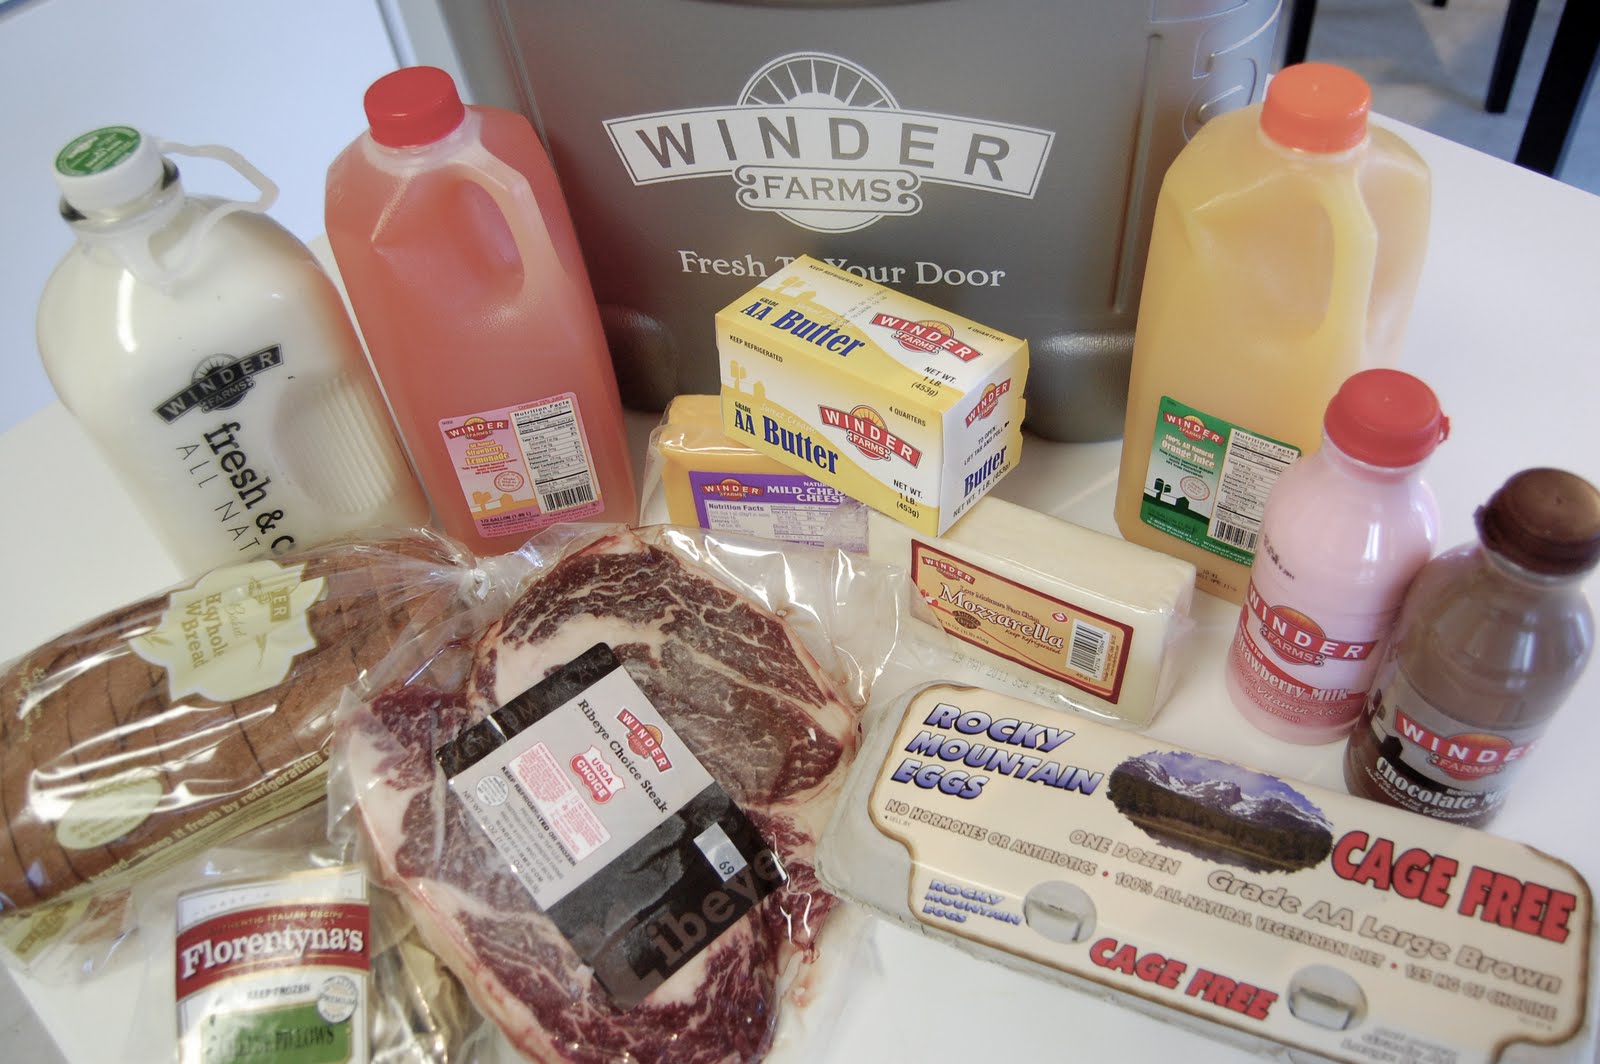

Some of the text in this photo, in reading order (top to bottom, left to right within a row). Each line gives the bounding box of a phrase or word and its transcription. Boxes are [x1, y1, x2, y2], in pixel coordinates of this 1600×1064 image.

[635, 116, 1011, 182] WINDER
[762, 176, 892, 202] FARMS
[678, 250, 767, 278] Fresh
[916, 261, 1006, 287] Door
[809, 264, 824, 272] KEEP
[759, 297, 779, 308] GRADE
[740, 301, 772, 321] AA
[771, 309, 866, 358] Butter
[880, 315, 975, 359] WINDER
[901, 334, 935, 353] FARMS
[974, 327, 1004, 343] QUARTERS
[729, 334, 784, 363] KEEP REFRIGERATED
[163, 349, 279, 419] WINDER
[923, 366, 941, 379] NET
[208, 379, 250, 408] FARMS
[910, 381, 939, 398] (453g)
[967, 381, 1008, 423] WINDER
[514, 406, 547, 417] Nutrition
[549, 400, 570, 409] Facts
[735, 401, 752, 414] GRADE
[895, 408, 927, 428] QUARTERS
[450, 421, 504, 437] WINDER
[735, 408, 839, 475] AA Butter
[825, 408, 918, 461] WINDER
[1166, 413, 1220, 443] WINDER
[466, 445, 503, 456] Strawberry
[853, 433, 884, 456] FARMS
[964, 453, 974, 467] LIFT
[983, 435, 993, 448] AND
[1161, 440, 1192, 459] Orange
[1193, 454, 1216, 469] Juice
[1234, 431, 1295, 456] Nutrition Facts
[466, 452, 509, 465] Lemonade
[963, 445, 1007, 499] Butter
[203, 421, 273, 511] fresh
[254, 508, 286, 535] &
[704, 485, 760, 495] WINDER
[767, 485, 845, 497] MILD CHED
[893, 479, 908, 491] NET
[175, 441, 261, 554] ALL NAT
[708, 503, 742, 511] Nutrition
[896, 499, 920, 519] (453g)
[953, 502, 965, 518] NET
[490, 515, 512, 523] GALLON
[925, 558, 972, 582] WINDER
[939, 582, 1065, 650] Mozzarella
[1250, 584, 1364, 659] WINDER
[1004, 629, 1062, 655] Keep Refrigerated
[1268, 631, 1314, 663] FARMS
[967, 657, 985, 673] MAY
[1256, 686, 1310, 717] Vitamin
[1310, 687, 1350, 701] Milk
[622, 713, 668, 768] WINDER
[923, 702, 1075, 753] ROCKY
[578, 699, 668, 813] Ribeye Choice Steak
[905, 731, 1104, 796] MOUNTAIN
[1439, 758, 1498, 775] FARMS
[576, 759, 608, 798] CHOICE
[591, 757, 614, 786] USDA
[891, 758, 989, 800] EGGS
[1376, 756, 1477, 810] Chocolate
[185, 810, 222, 834] fresh
[222, 800, 241, 817] by
[241, 755, 323, 808] refrigerating
[501, 765, 516, 783] KEEP
[515, 782, 550, 832] REFRIGERATED
[548, 830, 558, 842] OR
[555, 840, 577, 867] FROZEN
[885, 799, 1099, 877] NO HORMONES OR ANTIBIOTICS
[1069, 830, 1182, 876] ONE DOZEN
[719, 861, 735, 876] 69
[928, 879, 1006, 907] ROCKY
[1331, 830, 1578, 944] CAGE FREE
[267, 911, 308, 922] ITALIAN
[310, 910, 345, 920] RECIPE
[921, 904, 968, 925] EGGS
[923, 892, 1023, 927] MOUNTAIN
[1207, 869, 1563, 995] Grade AA Large Brown
[182, 924, 364, 980] Florentyna's
[1116, 871, 1152, 895] 100%
[1155, 885, 1252, 928] ALL-NATURAL
[1256, 914, 1349, 957] VEGETARIAN
[1351, 946, 1386, 968] DIET
[1434, 973, 1461, 994] MG
[1463, 981, 1486, 1000] OF
[1487, 988, 1558, 1023] CHOLINE
[273, 983, 312, 997] FROZEN
[1089, 937, 1279, 1021] CAGE FREE
